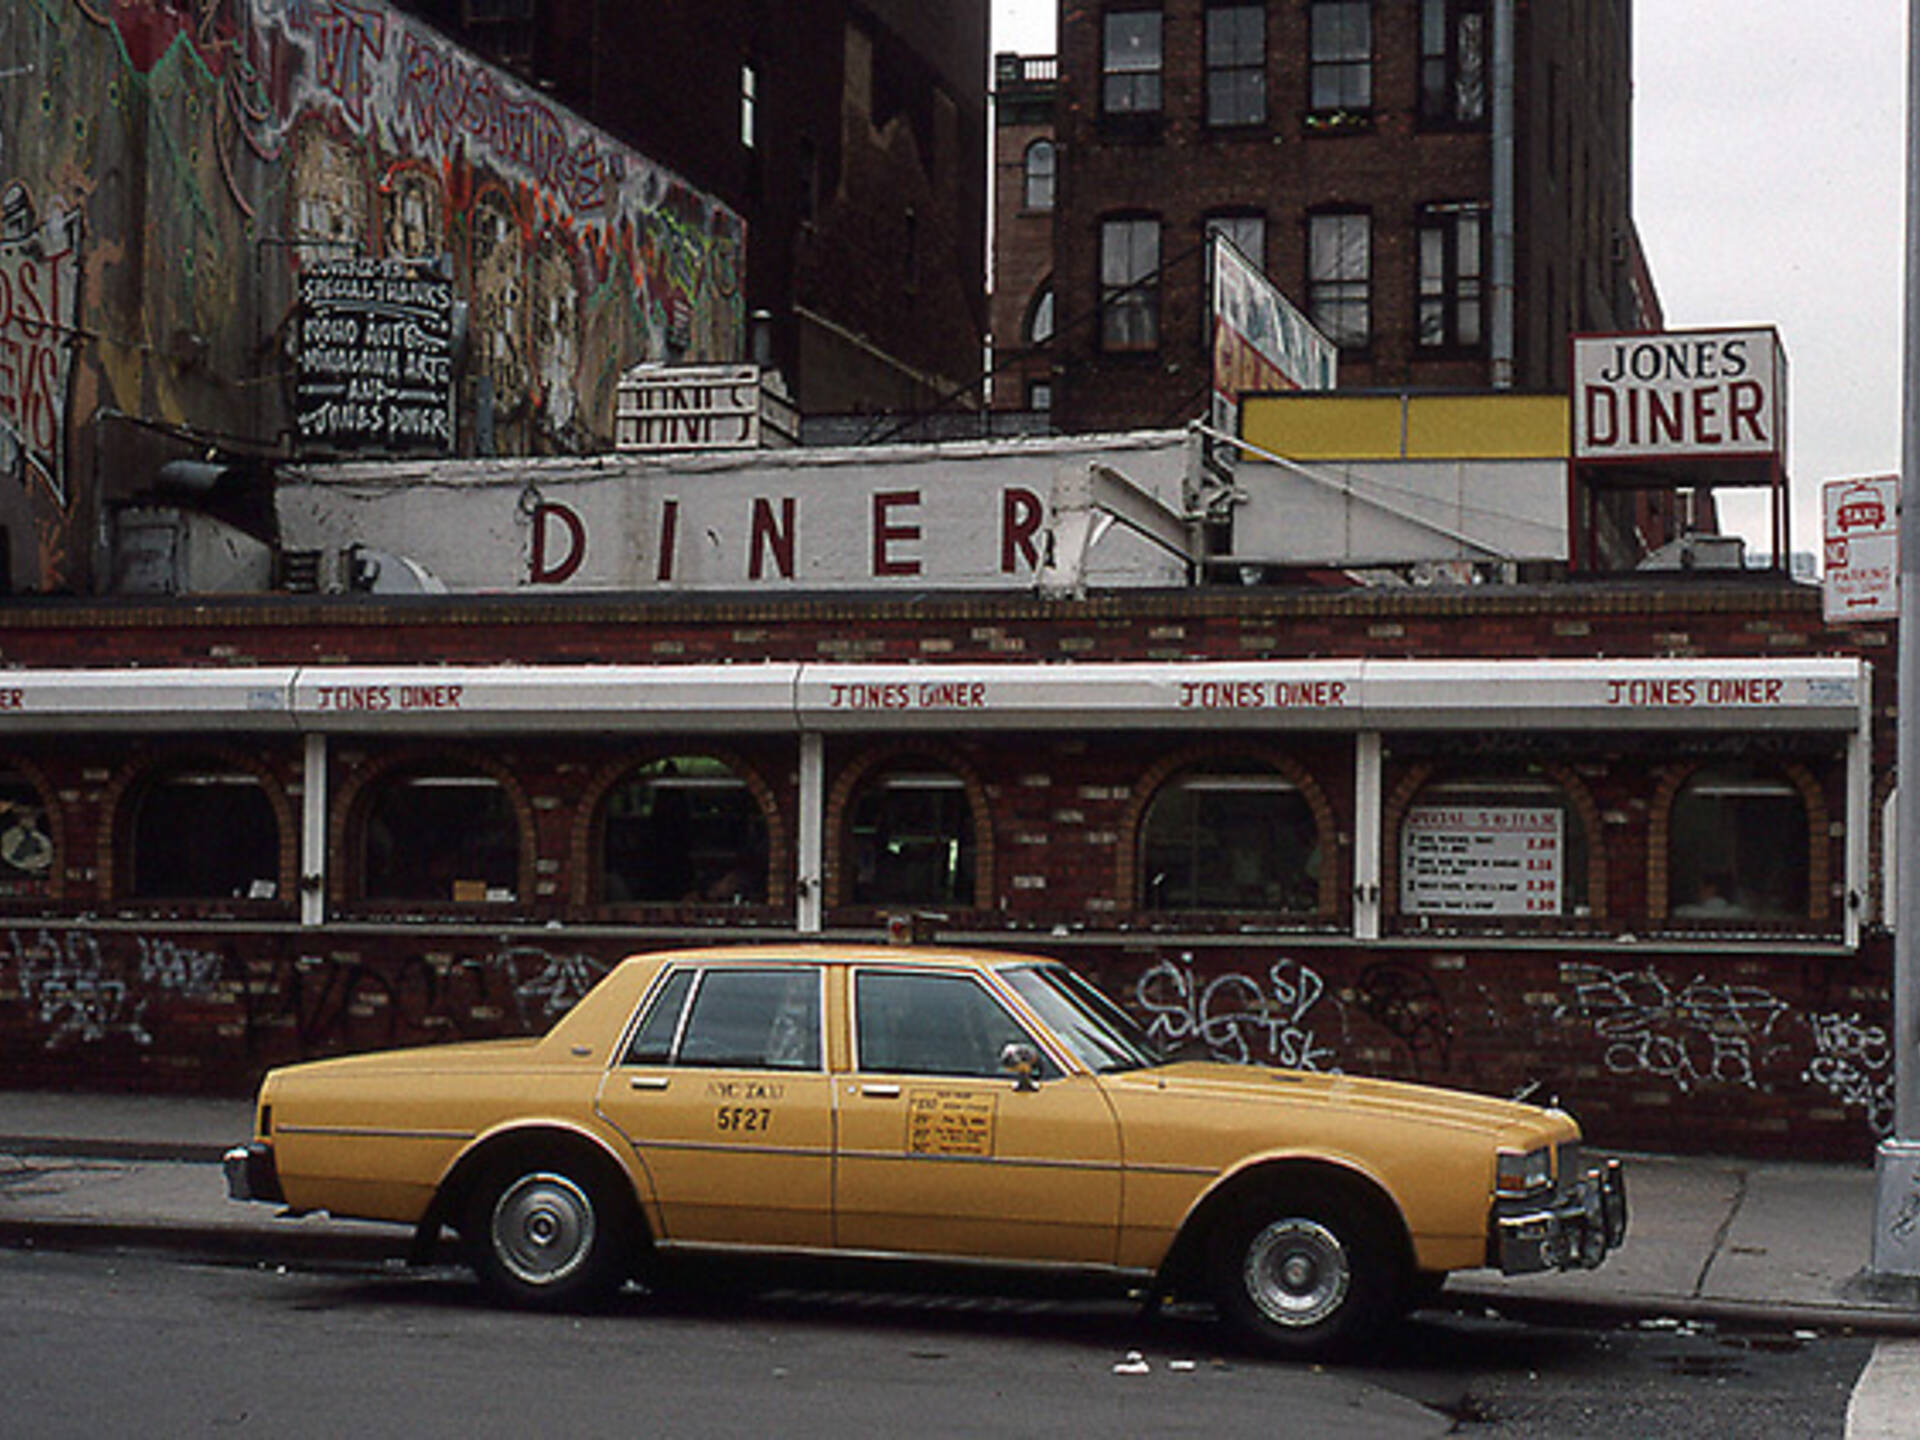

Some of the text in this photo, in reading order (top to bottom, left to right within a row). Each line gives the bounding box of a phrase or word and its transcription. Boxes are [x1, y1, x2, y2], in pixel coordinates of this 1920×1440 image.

[1602, 340, 1747, 382] JONES
[1585, 379, 1768, 448] DINER
[530, 487, 1053, 585] DINER
[317, 685, 464, 709] JONES DINER
[830, 683, 909, 707] JONES
[1180, 682, 1347, 706] JONES DINER
[1608, 680, 1696, 704] JONES
[1707, 679, 1784, 704] DINER
[717, 1105, 772, 1132] 5F27
